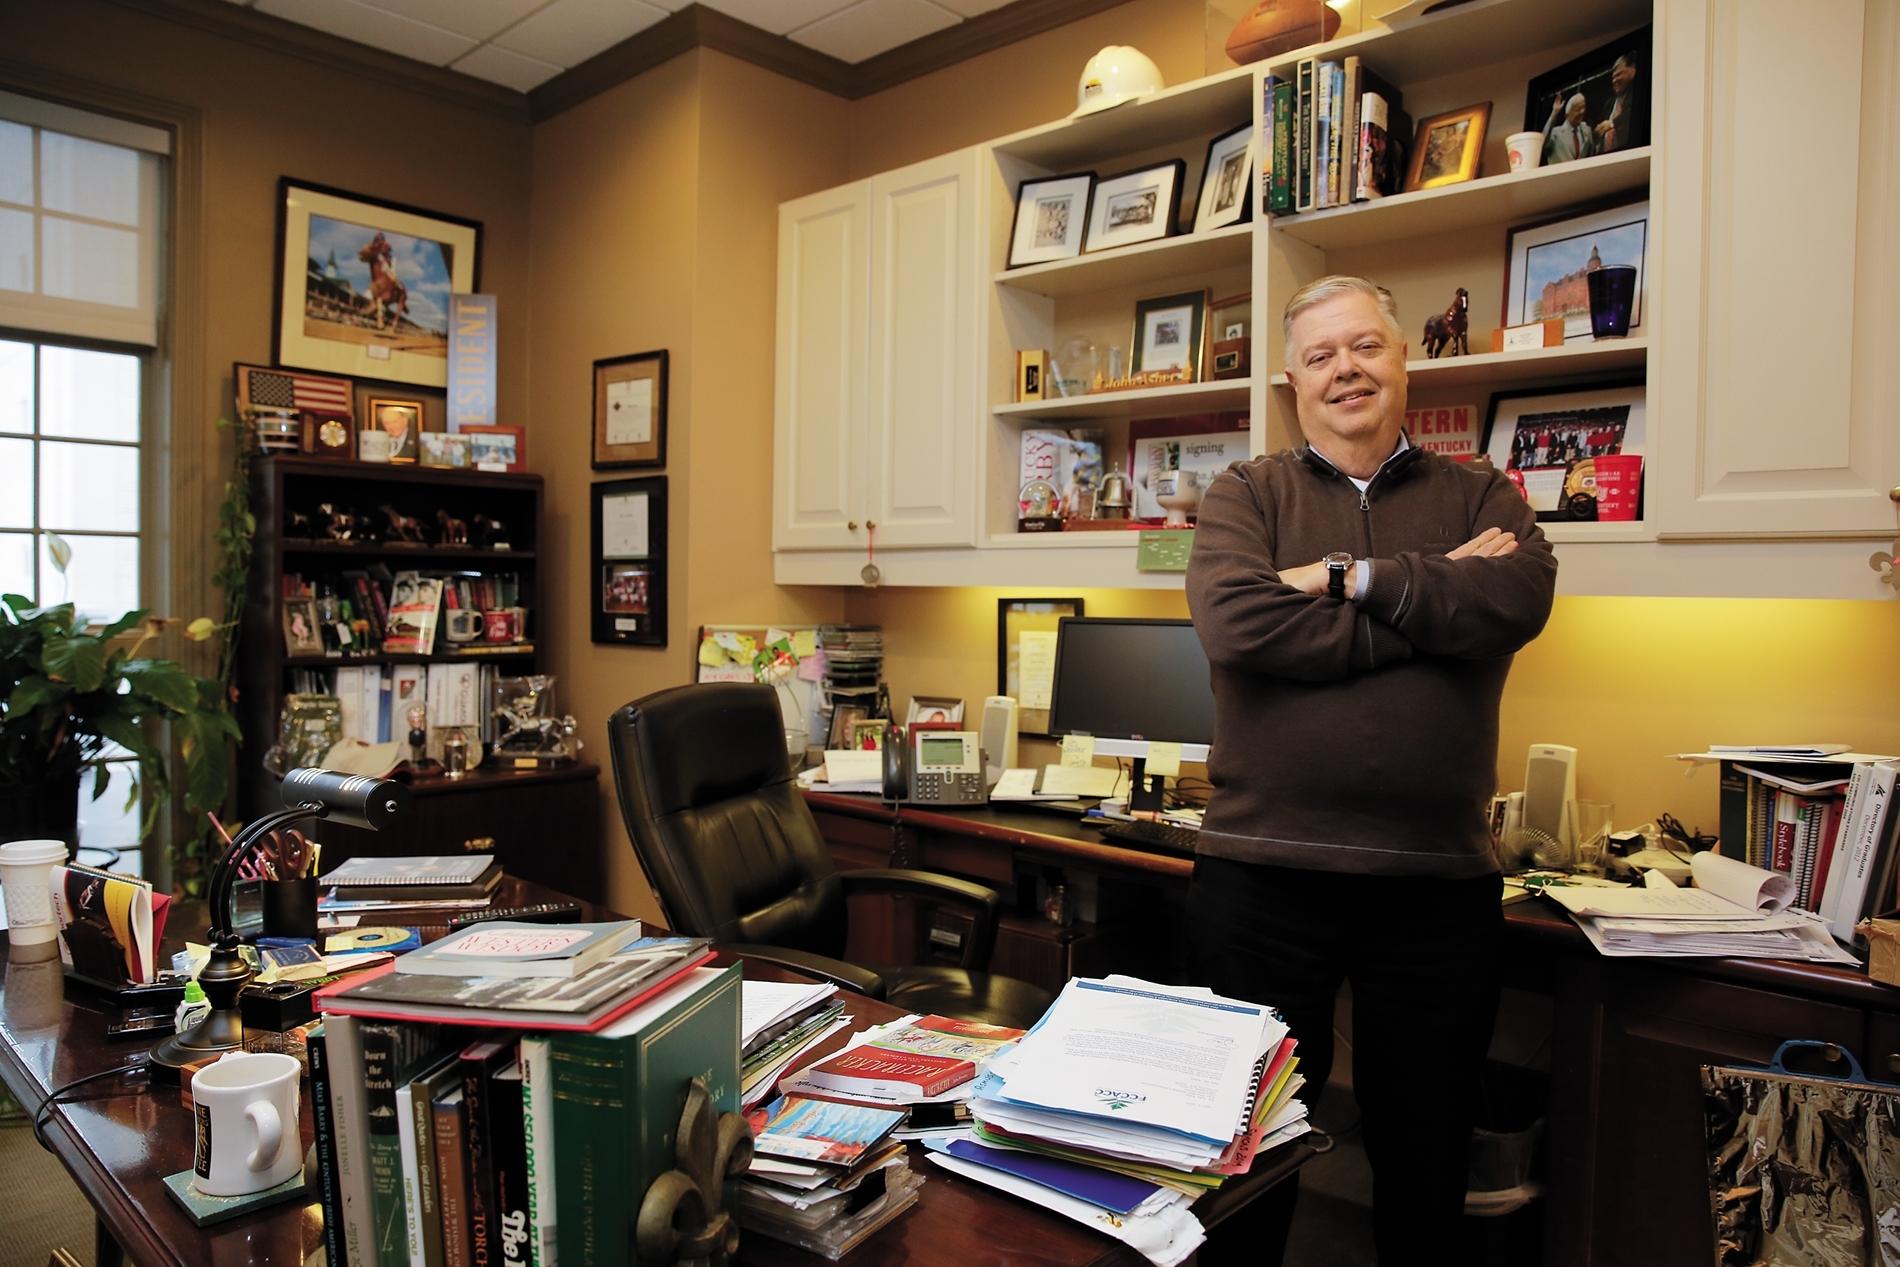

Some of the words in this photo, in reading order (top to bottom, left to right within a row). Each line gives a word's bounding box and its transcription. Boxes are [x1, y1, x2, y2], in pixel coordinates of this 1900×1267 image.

[456, 303, 488, 424] ESIDENT
[1404, 407, 1469, 436] TERN
[1186, 442, 1225, 457] signing
[1866, 803, 1882, 835] Directory
[1775, 823, 1789, 869] Stylebook
[1866, 836, 1873, 844] of
[1856, 844, 1871, 880] Graduates
[314, 1081, 326, 1104] MIKE
[316, 1105, 328, 1132] BARRY
[414, 1101, 427, 1123] Great
[319, 1133, 329, 1142] &
[320, 1143, 330, 1160] THE
[322, 1160, 333, 1203] KENTUCKY
[420, 1165, 430, 1185] Great
[404, 1177, 417, 1214] HERE'S
[421, 1186, 434, 1214] Leaders
[325, 1204, 335, 1227] IRISH
[407, 1216, 417, 1231] TO
[501, 1210, 527, 1258] The
